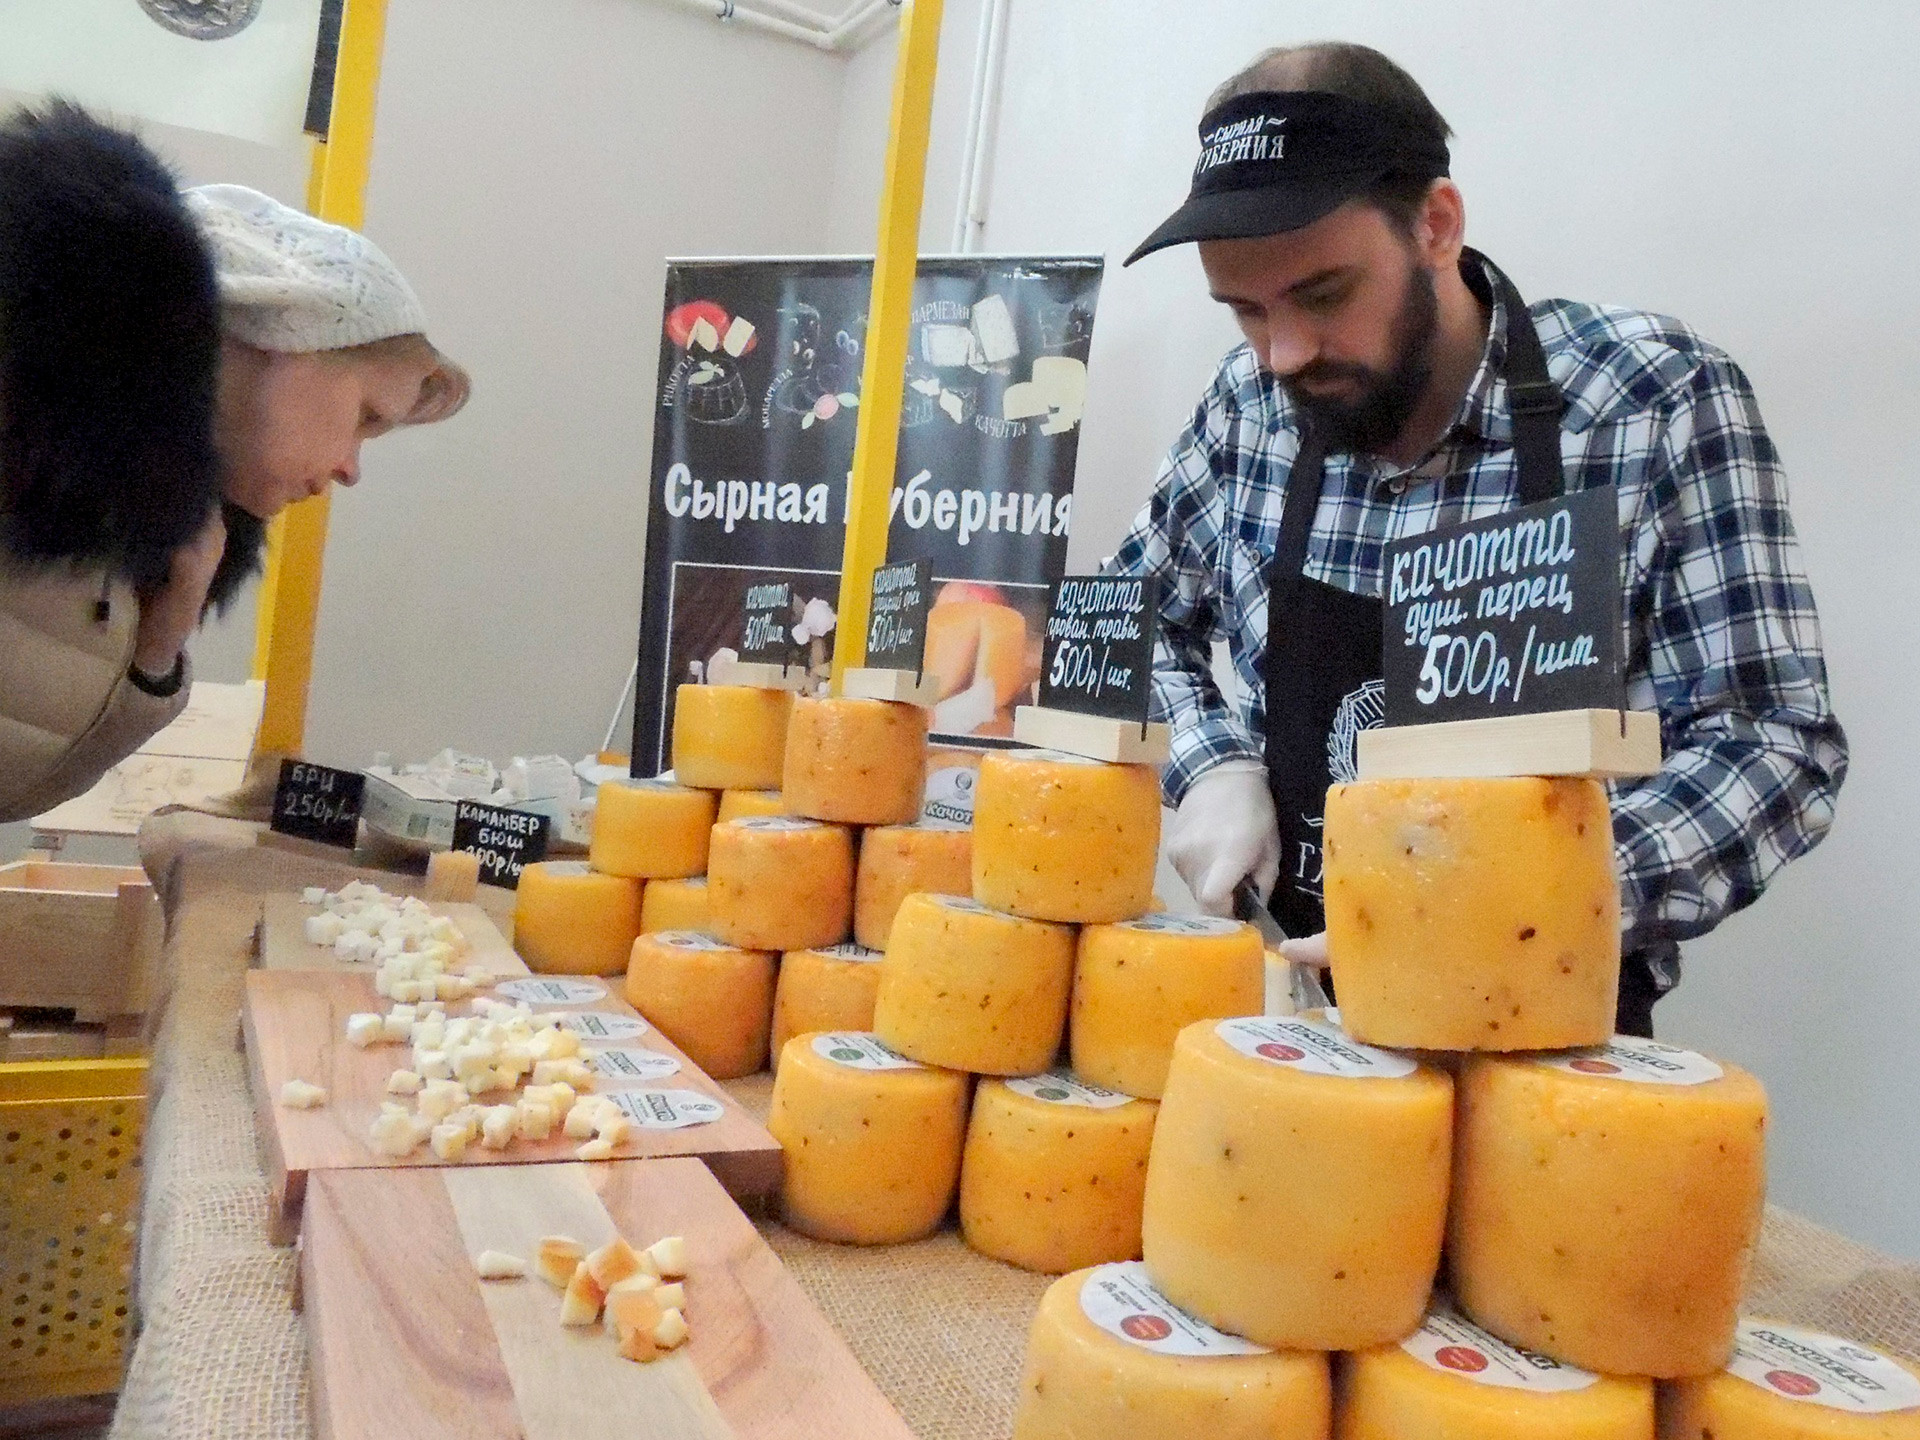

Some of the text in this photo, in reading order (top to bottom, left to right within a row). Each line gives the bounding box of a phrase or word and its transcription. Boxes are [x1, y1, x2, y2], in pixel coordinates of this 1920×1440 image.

[1214, 115, 1265, 143] СЫРНАЯ
[664, 462, 829, 533] Сырная
[1092, 613, 1142, 644] травы
[1405, 573, 1573, 646] душ. перец
